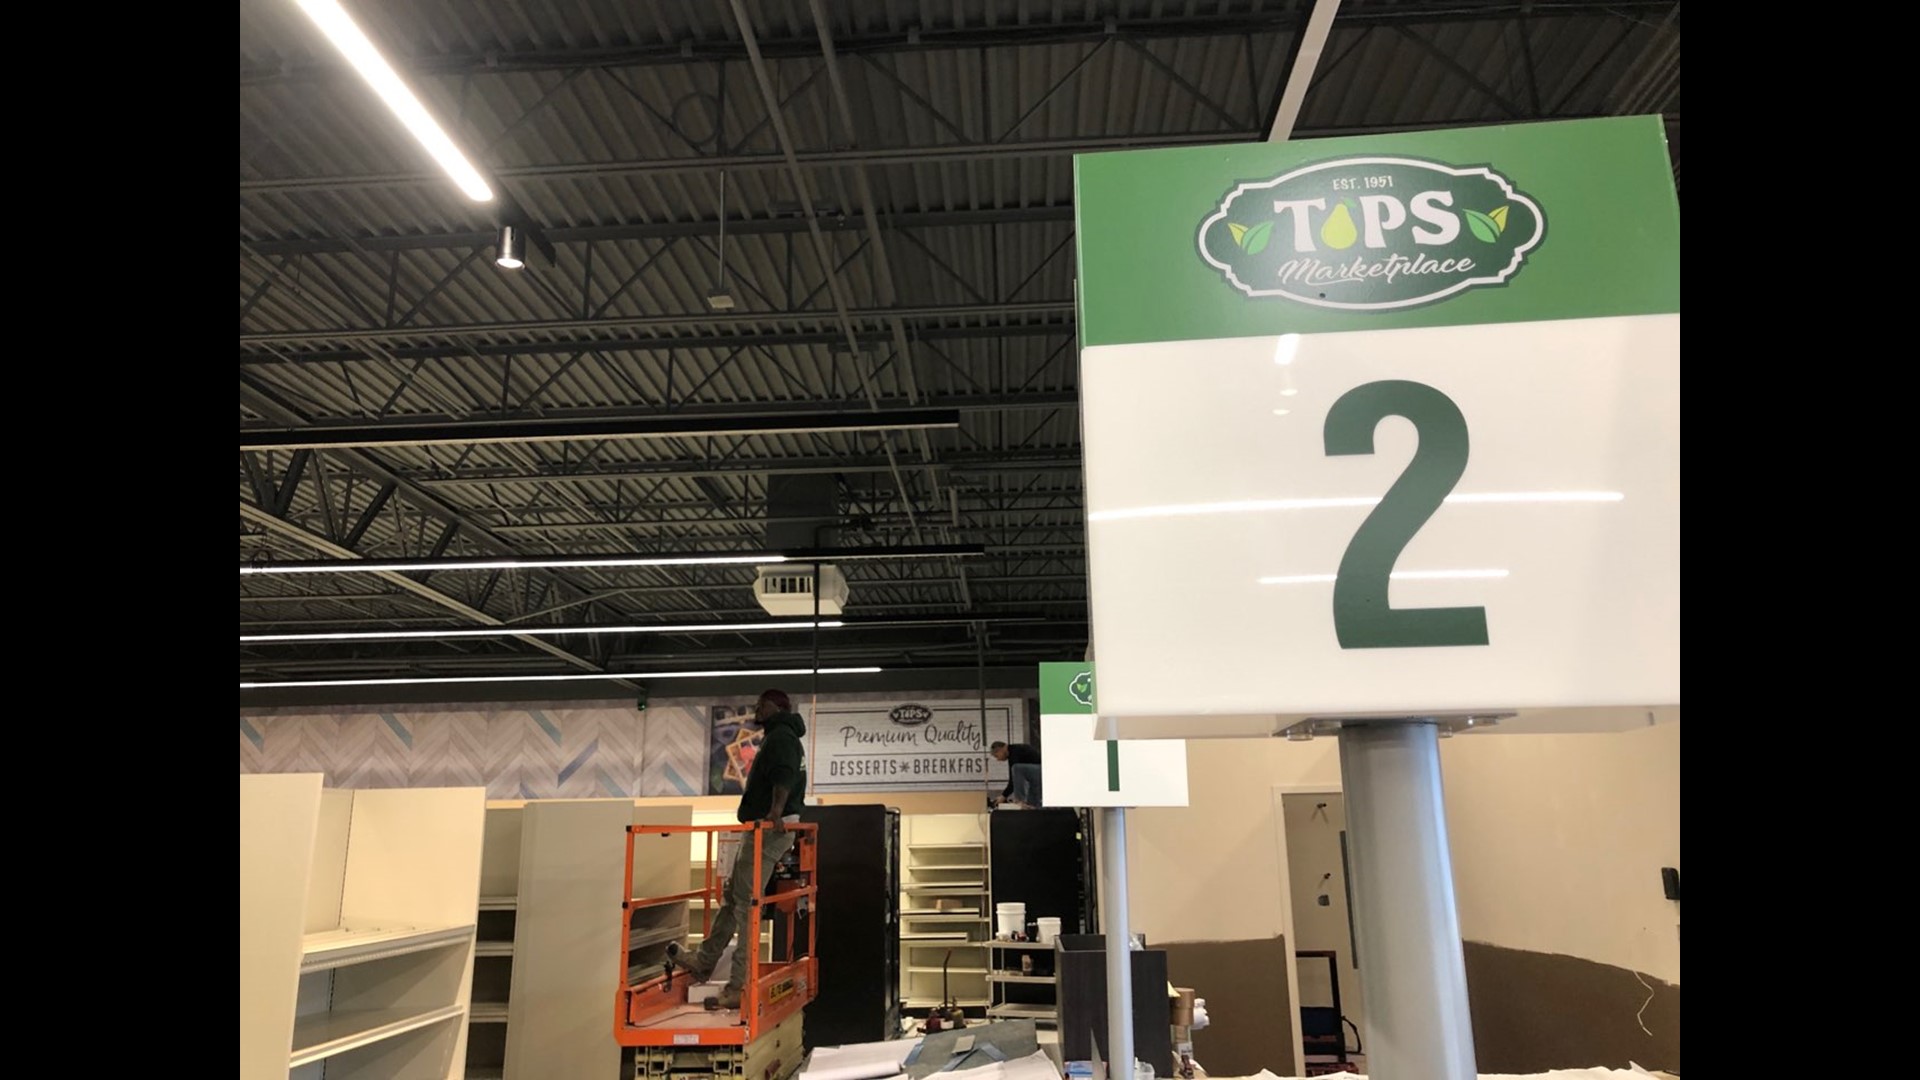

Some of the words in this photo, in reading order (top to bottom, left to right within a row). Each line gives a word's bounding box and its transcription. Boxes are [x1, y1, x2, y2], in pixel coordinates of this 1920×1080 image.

[1333, 178, 1361, 191] EST.
[1365, 175, 1394, 189] 1951
[1277, 253, 1477, 286] Marketplace
[1323, 379, 1490, 650] 2
[839, 725, 918, 748] Premium
[924, 720, 982, 751] Quality
[830, 759, 897, 777] DESSERTS
[913, 758, 990, 775] BREAKFAST
